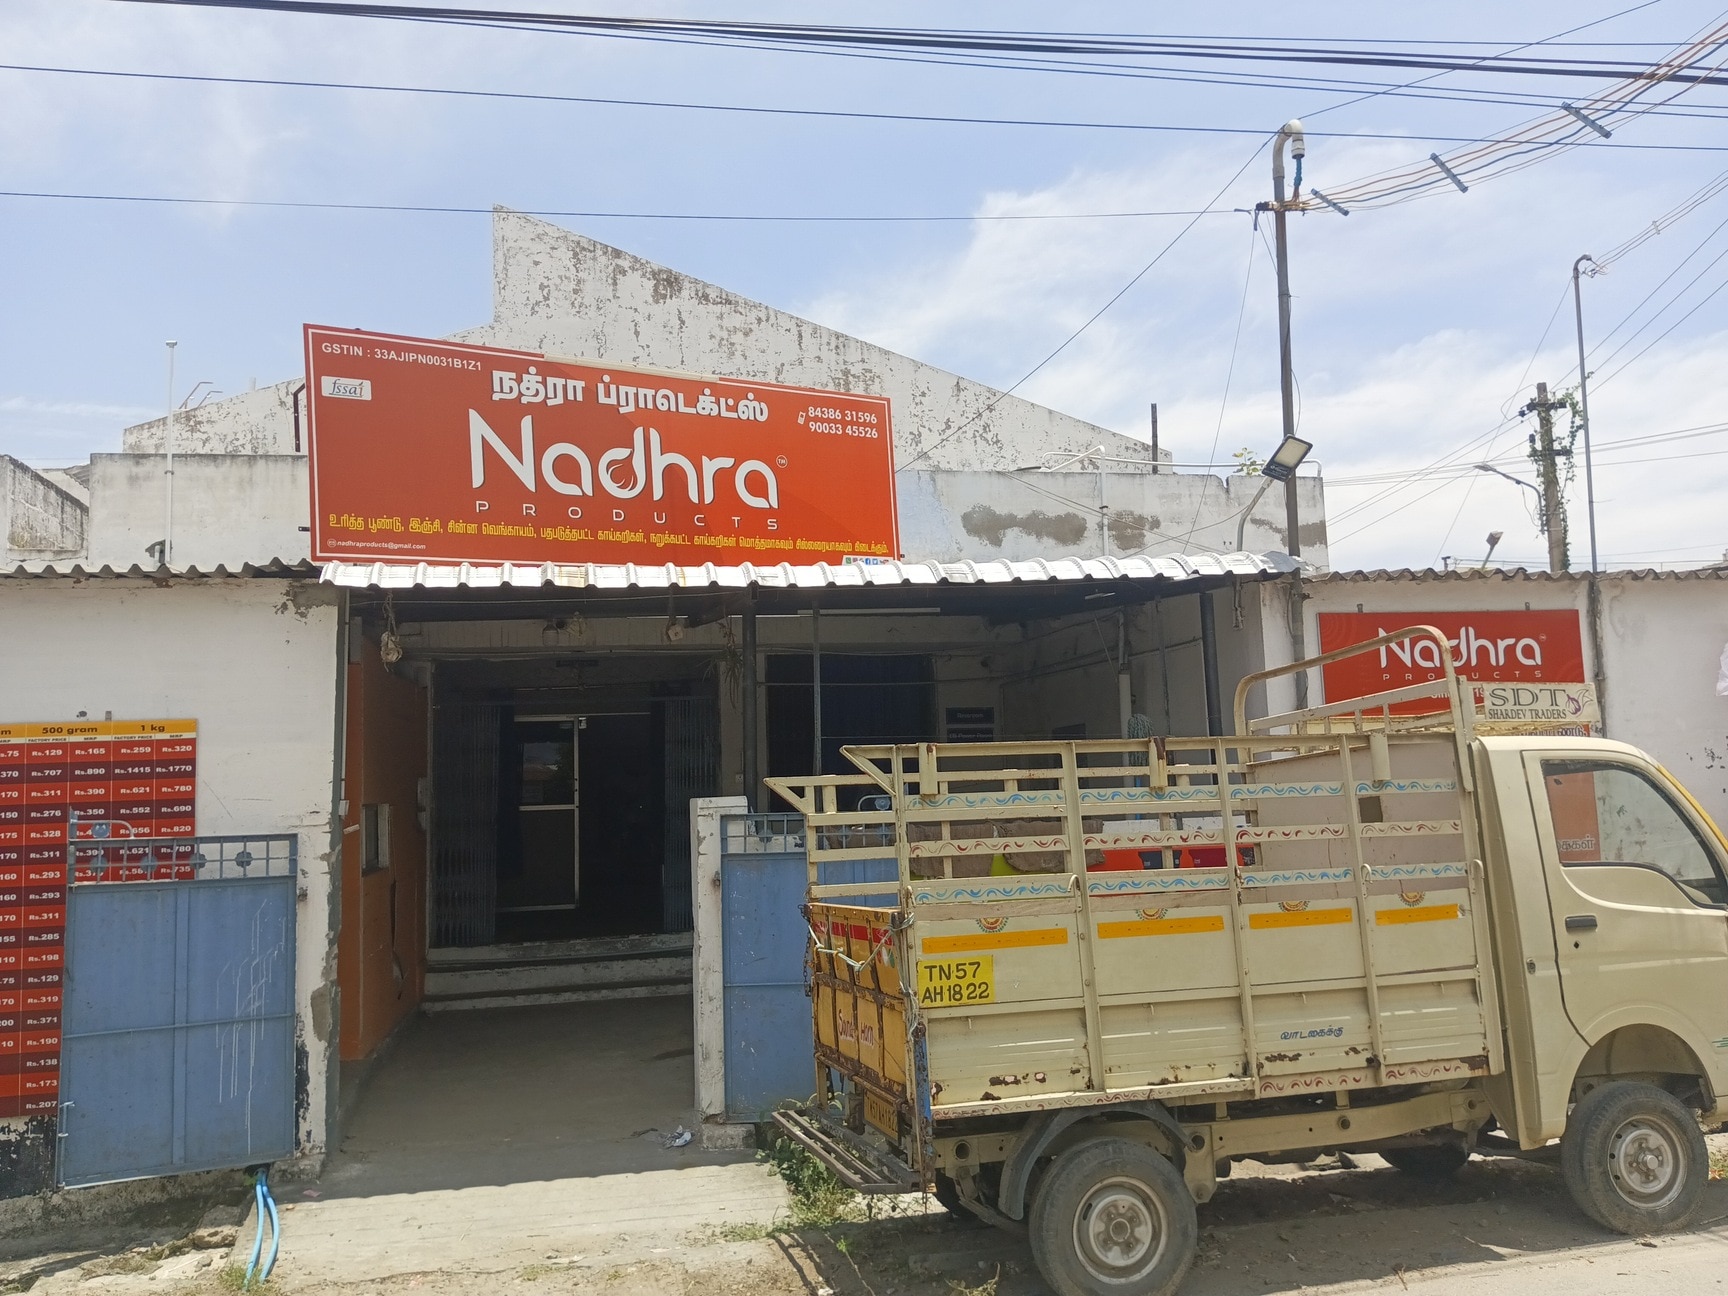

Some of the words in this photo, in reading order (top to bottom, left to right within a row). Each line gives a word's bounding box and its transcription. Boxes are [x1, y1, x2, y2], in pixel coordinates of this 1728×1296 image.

[322, 342, 363, 357] GSTIN
[374, 348, 482, 371] 33AJIPN0031B1Z1
[329, 378, 364, 398] fssai
[491, 365, 585, 407] நத்ரா
[596, 373, 769, 423] ப்ராடெக்ட்ஸ்
[808, 406, 841, 420] 84386
[844, 410, 877, 424] 31596
[809, 421, 842, 434] 90033
[845, 425, 878, 438] 45526
[468, 408, 779, 510] Nadhra
[475, 500, 779, 531] PRODUCTS
[329, 513, 365, 531] உரித்த
[368, 515, 405, 533] பூண்டு,
[409, 517, 444, 535] இஞ்சி,
[448, 519, 478, 535] சின்ன
[482, 521, 537, 539] வெங்காயம்,
[694, 533, 736, 548] காய்கறிகள்
[336, 540, 427, 550] nadhraproducts@gmail.com
[1378, 626, 1542, 668] Nadhra
[1382, 670, 1542, 681] PROUCTS
[1489, 687, 1567, 707] SDT
[1488, 709, 1526, 720] SHARDEV
[1528, 709, 1567, 720] TRADERS
[67, 727, 98, 735] gram
[150, 724, 165, 732] kg
[30, 810, 62, 818] Rs.276
[29, 851, 60, 859] Rs.311
[29, 892, 61, 900] Rs.293
[28, 913, 59, 921] Rs.311
[27, 975, 59, 983] Rs.129
[27, 996, 59, 1004] Rs.319
[26, 1017, 58, 1025] Rs.371
[1280, 1024, 1344, 1040] வாடகைக்கு
[26, 1038, 58, 1046] Rs.190
[26, 1059, 58, 1067] Rs.138
[26, 1080, 58, 1088] Rs.173
[25, 1101, 58, 1109] Rs.207
